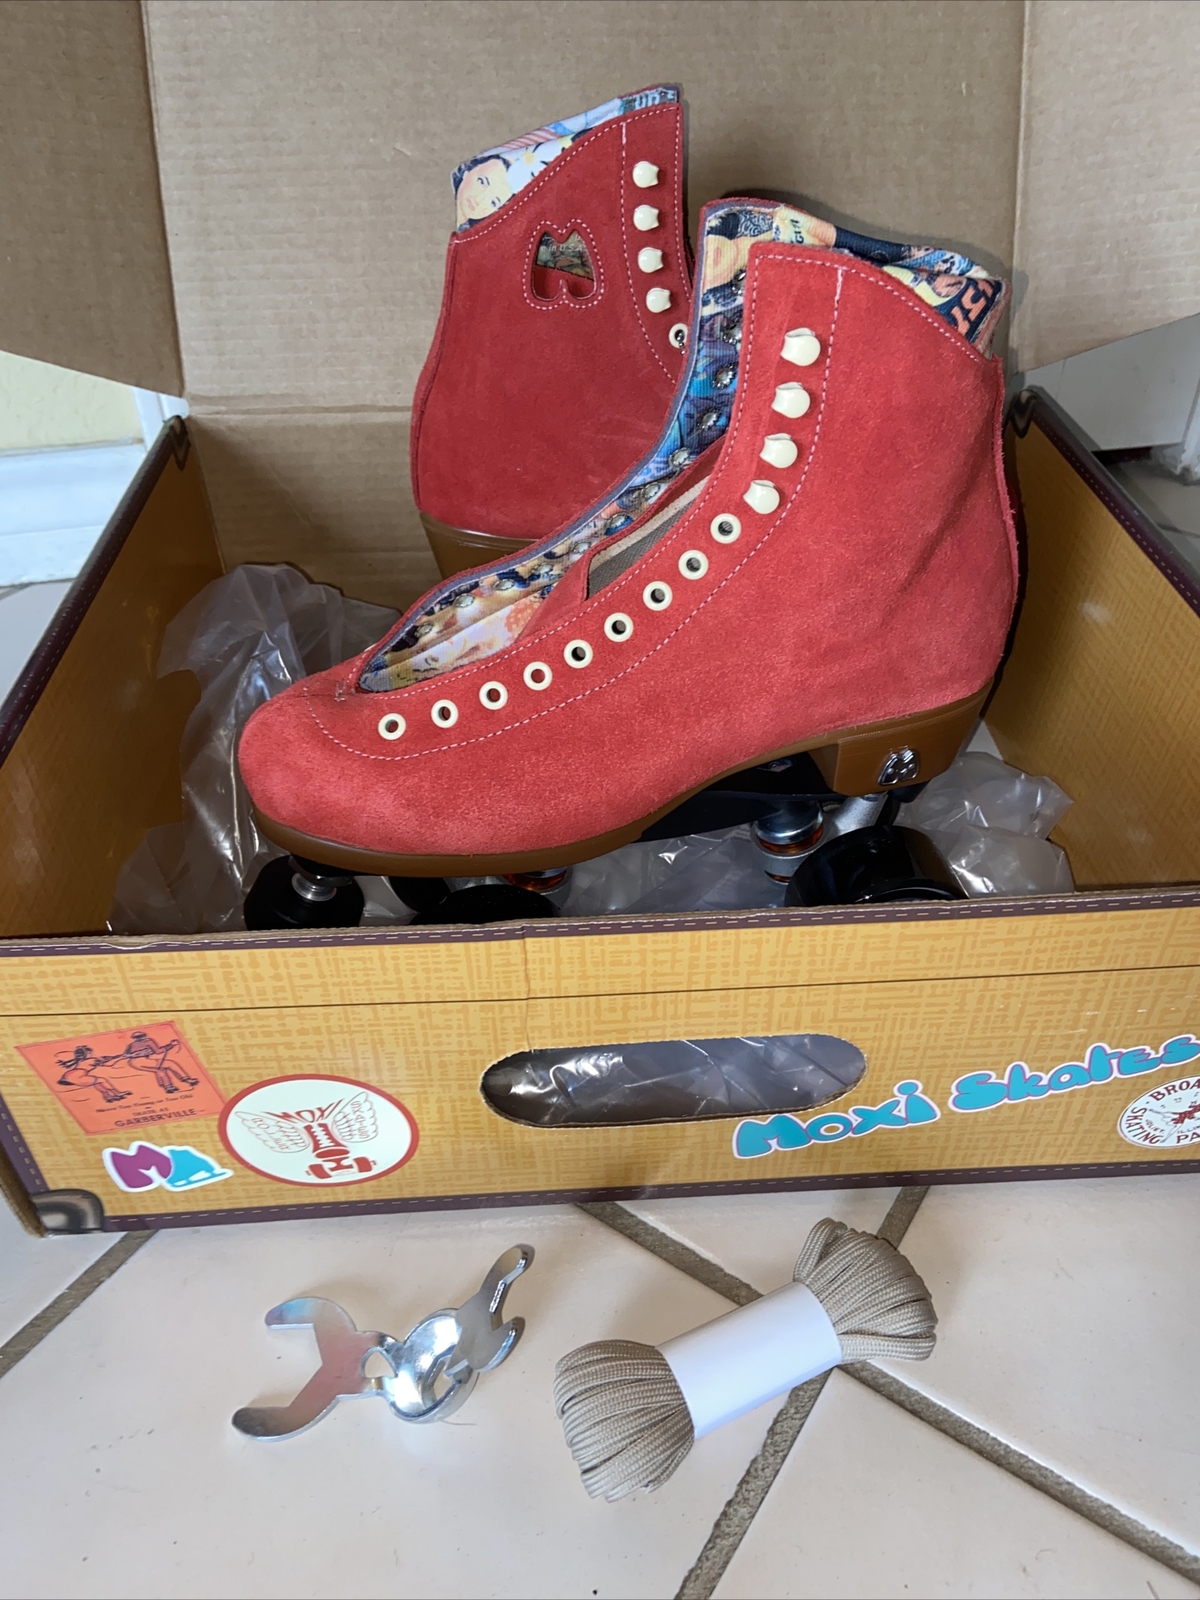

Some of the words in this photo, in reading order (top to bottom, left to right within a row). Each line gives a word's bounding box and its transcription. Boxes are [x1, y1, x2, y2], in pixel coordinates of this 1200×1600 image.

[735, 1082, 940, 1158] Moxi
[949, 1034, 1200, 1111] Skates
[115, 1109, 196, 1126] GARBERVILLE
[1125, 1107, 1164, 1144] SKATING
